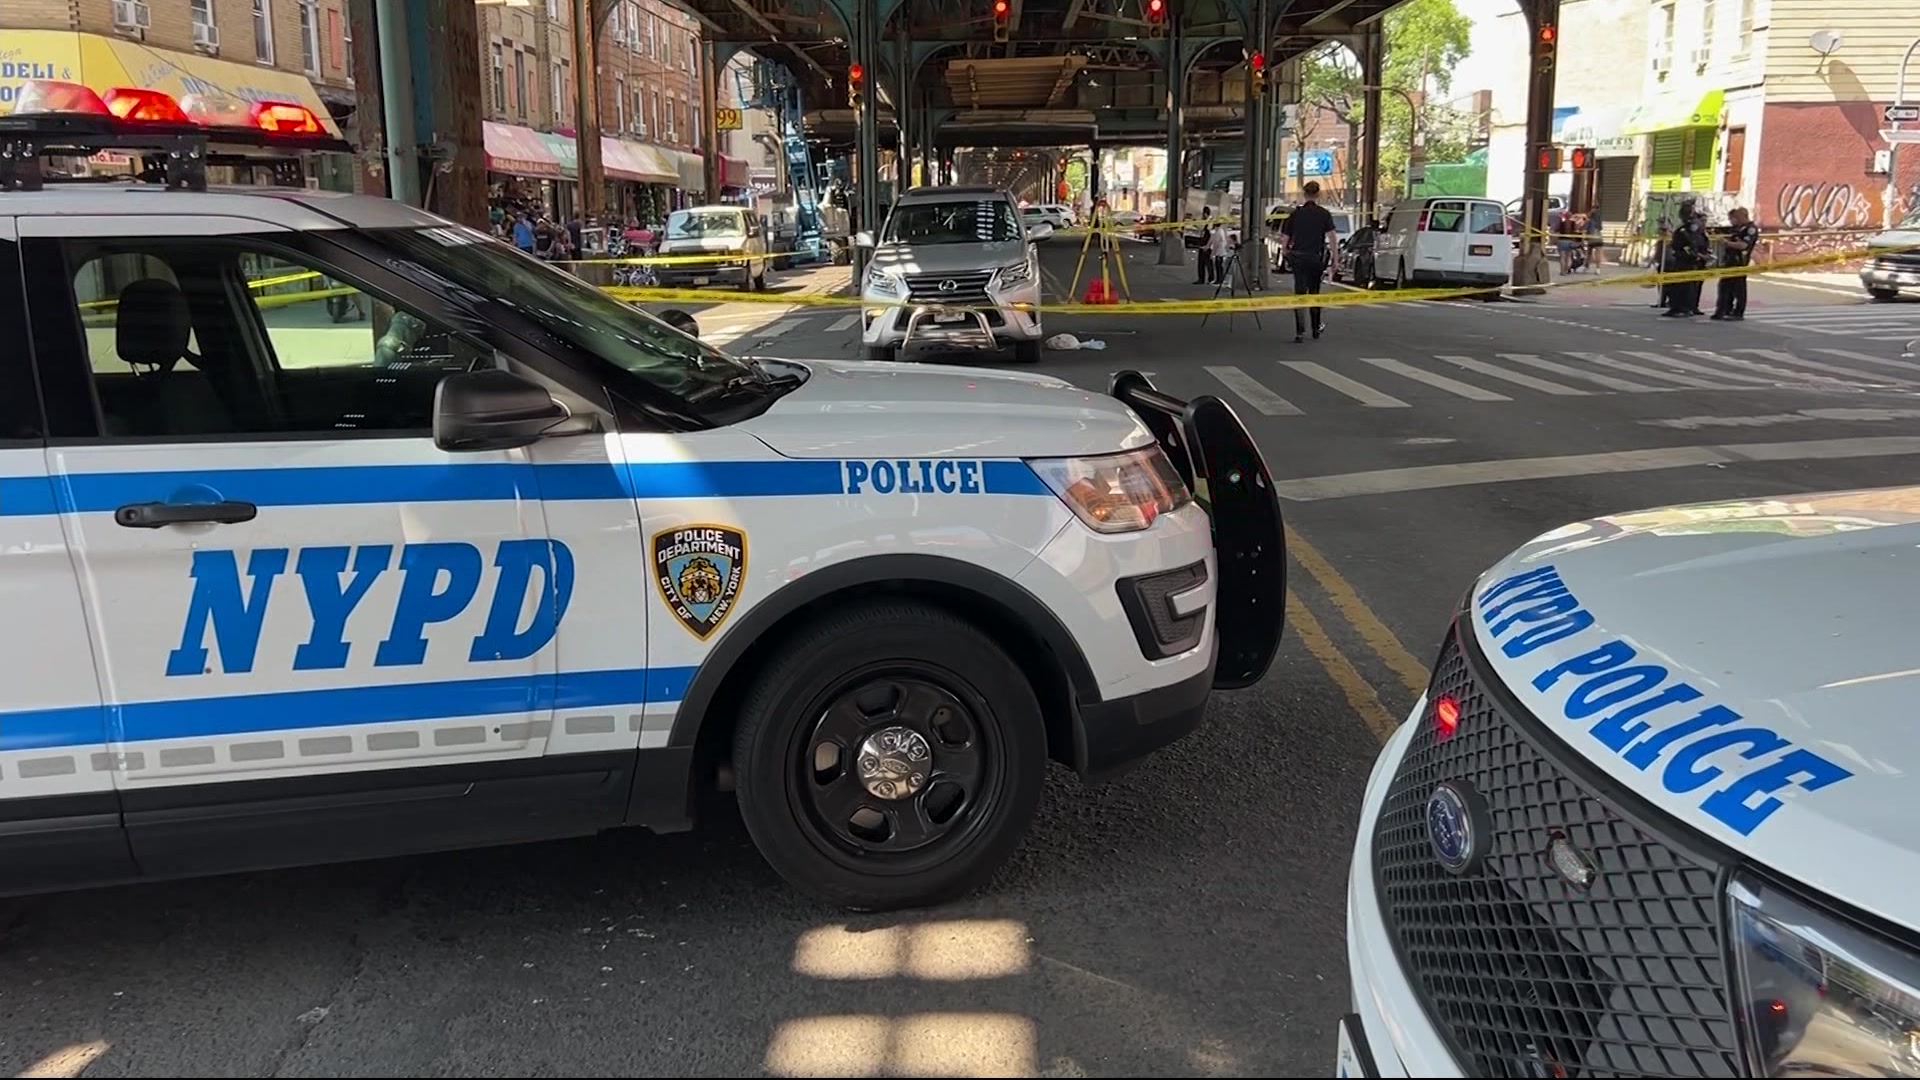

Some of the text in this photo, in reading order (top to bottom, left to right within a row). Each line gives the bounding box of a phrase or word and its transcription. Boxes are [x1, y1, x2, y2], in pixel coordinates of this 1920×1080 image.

[2, 62, 71, 80] DELI &
[846, 460, 979, 494] POLICE
[658, 541, 741, 564] DEPARTMENT
[674, 529, 724, 544] POLICE
[165, 539, 575, 677] NYPD
[661, 576, 693, 620] CITY OF
[708, 566, 741, 624] NEW YORK
[1478, 564, 1855, 837] NYPD POLICE
